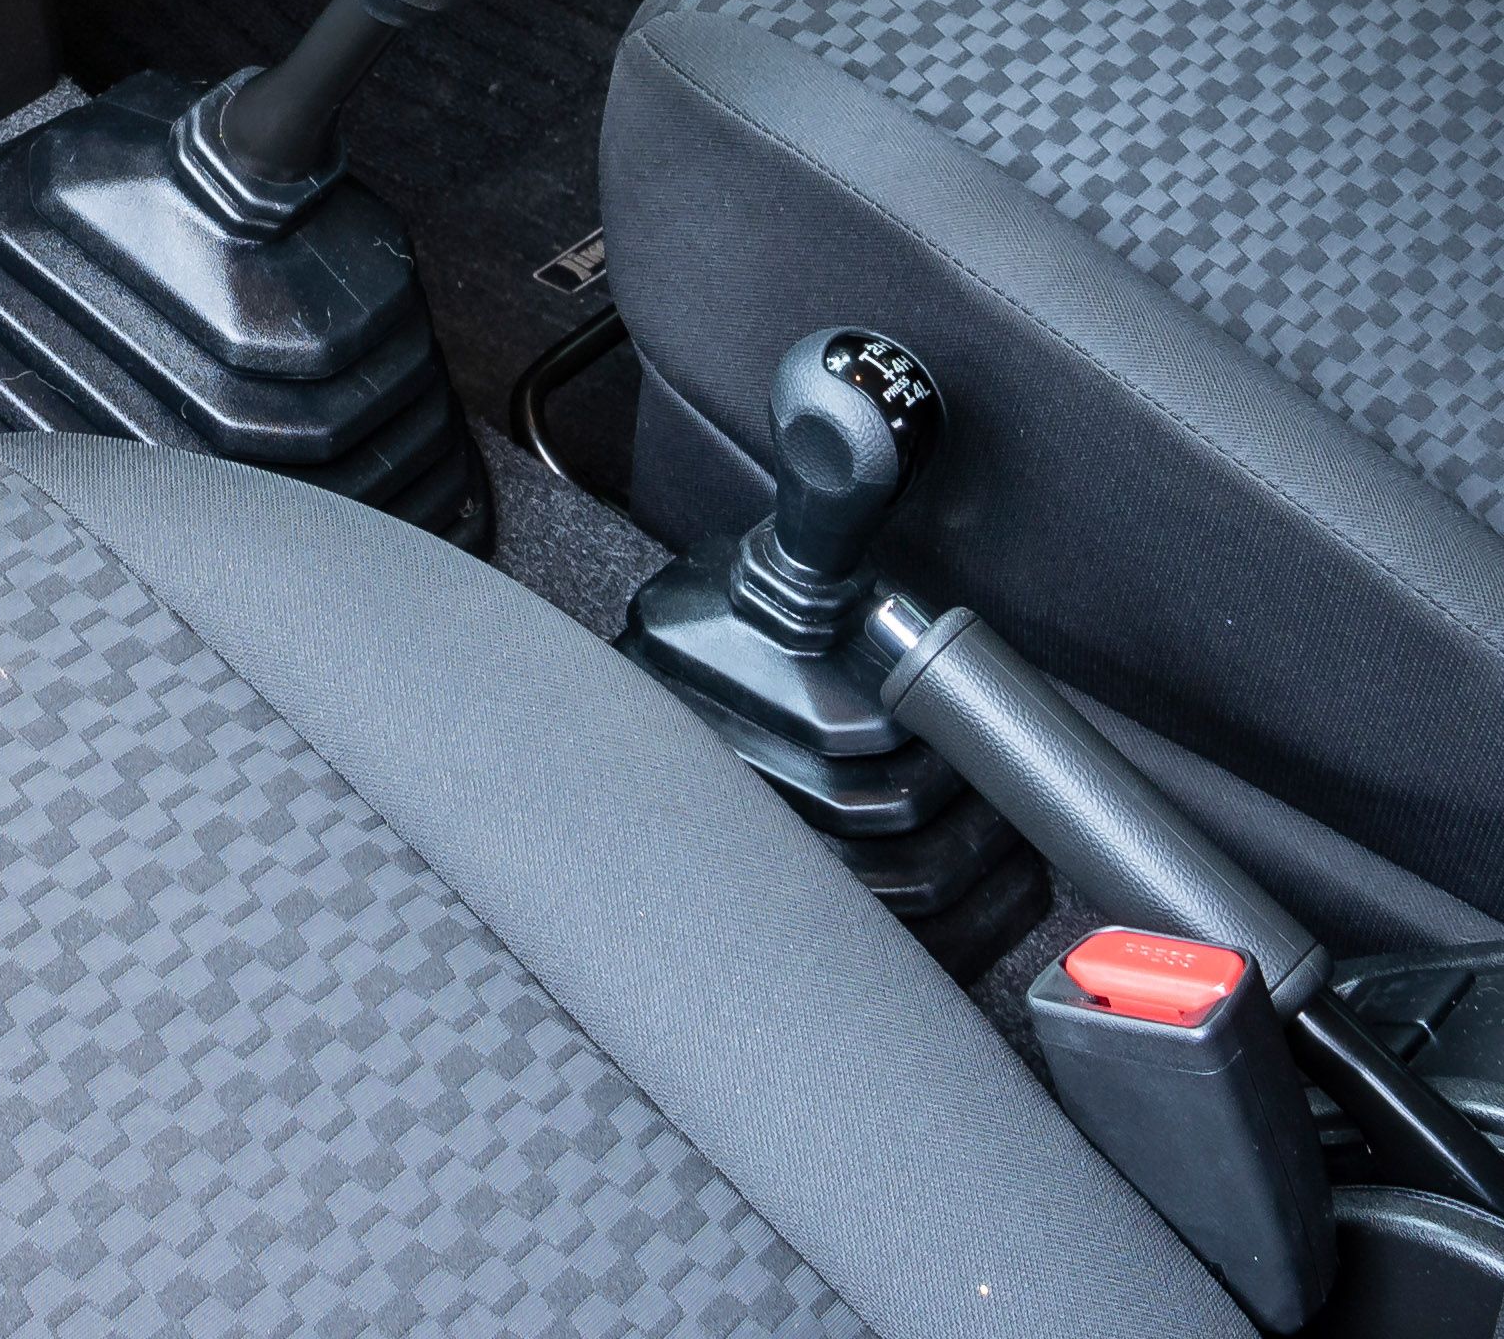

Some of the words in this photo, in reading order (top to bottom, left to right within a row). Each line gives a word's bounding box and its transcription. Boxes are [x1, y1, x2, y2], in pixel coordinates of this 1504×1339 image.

[865, 341, 892, 356] 2H
[892, 355, 914, 373] 4H
[882, 375, 911, 402] PRESS
[912, 379, 931, 399] 4L
